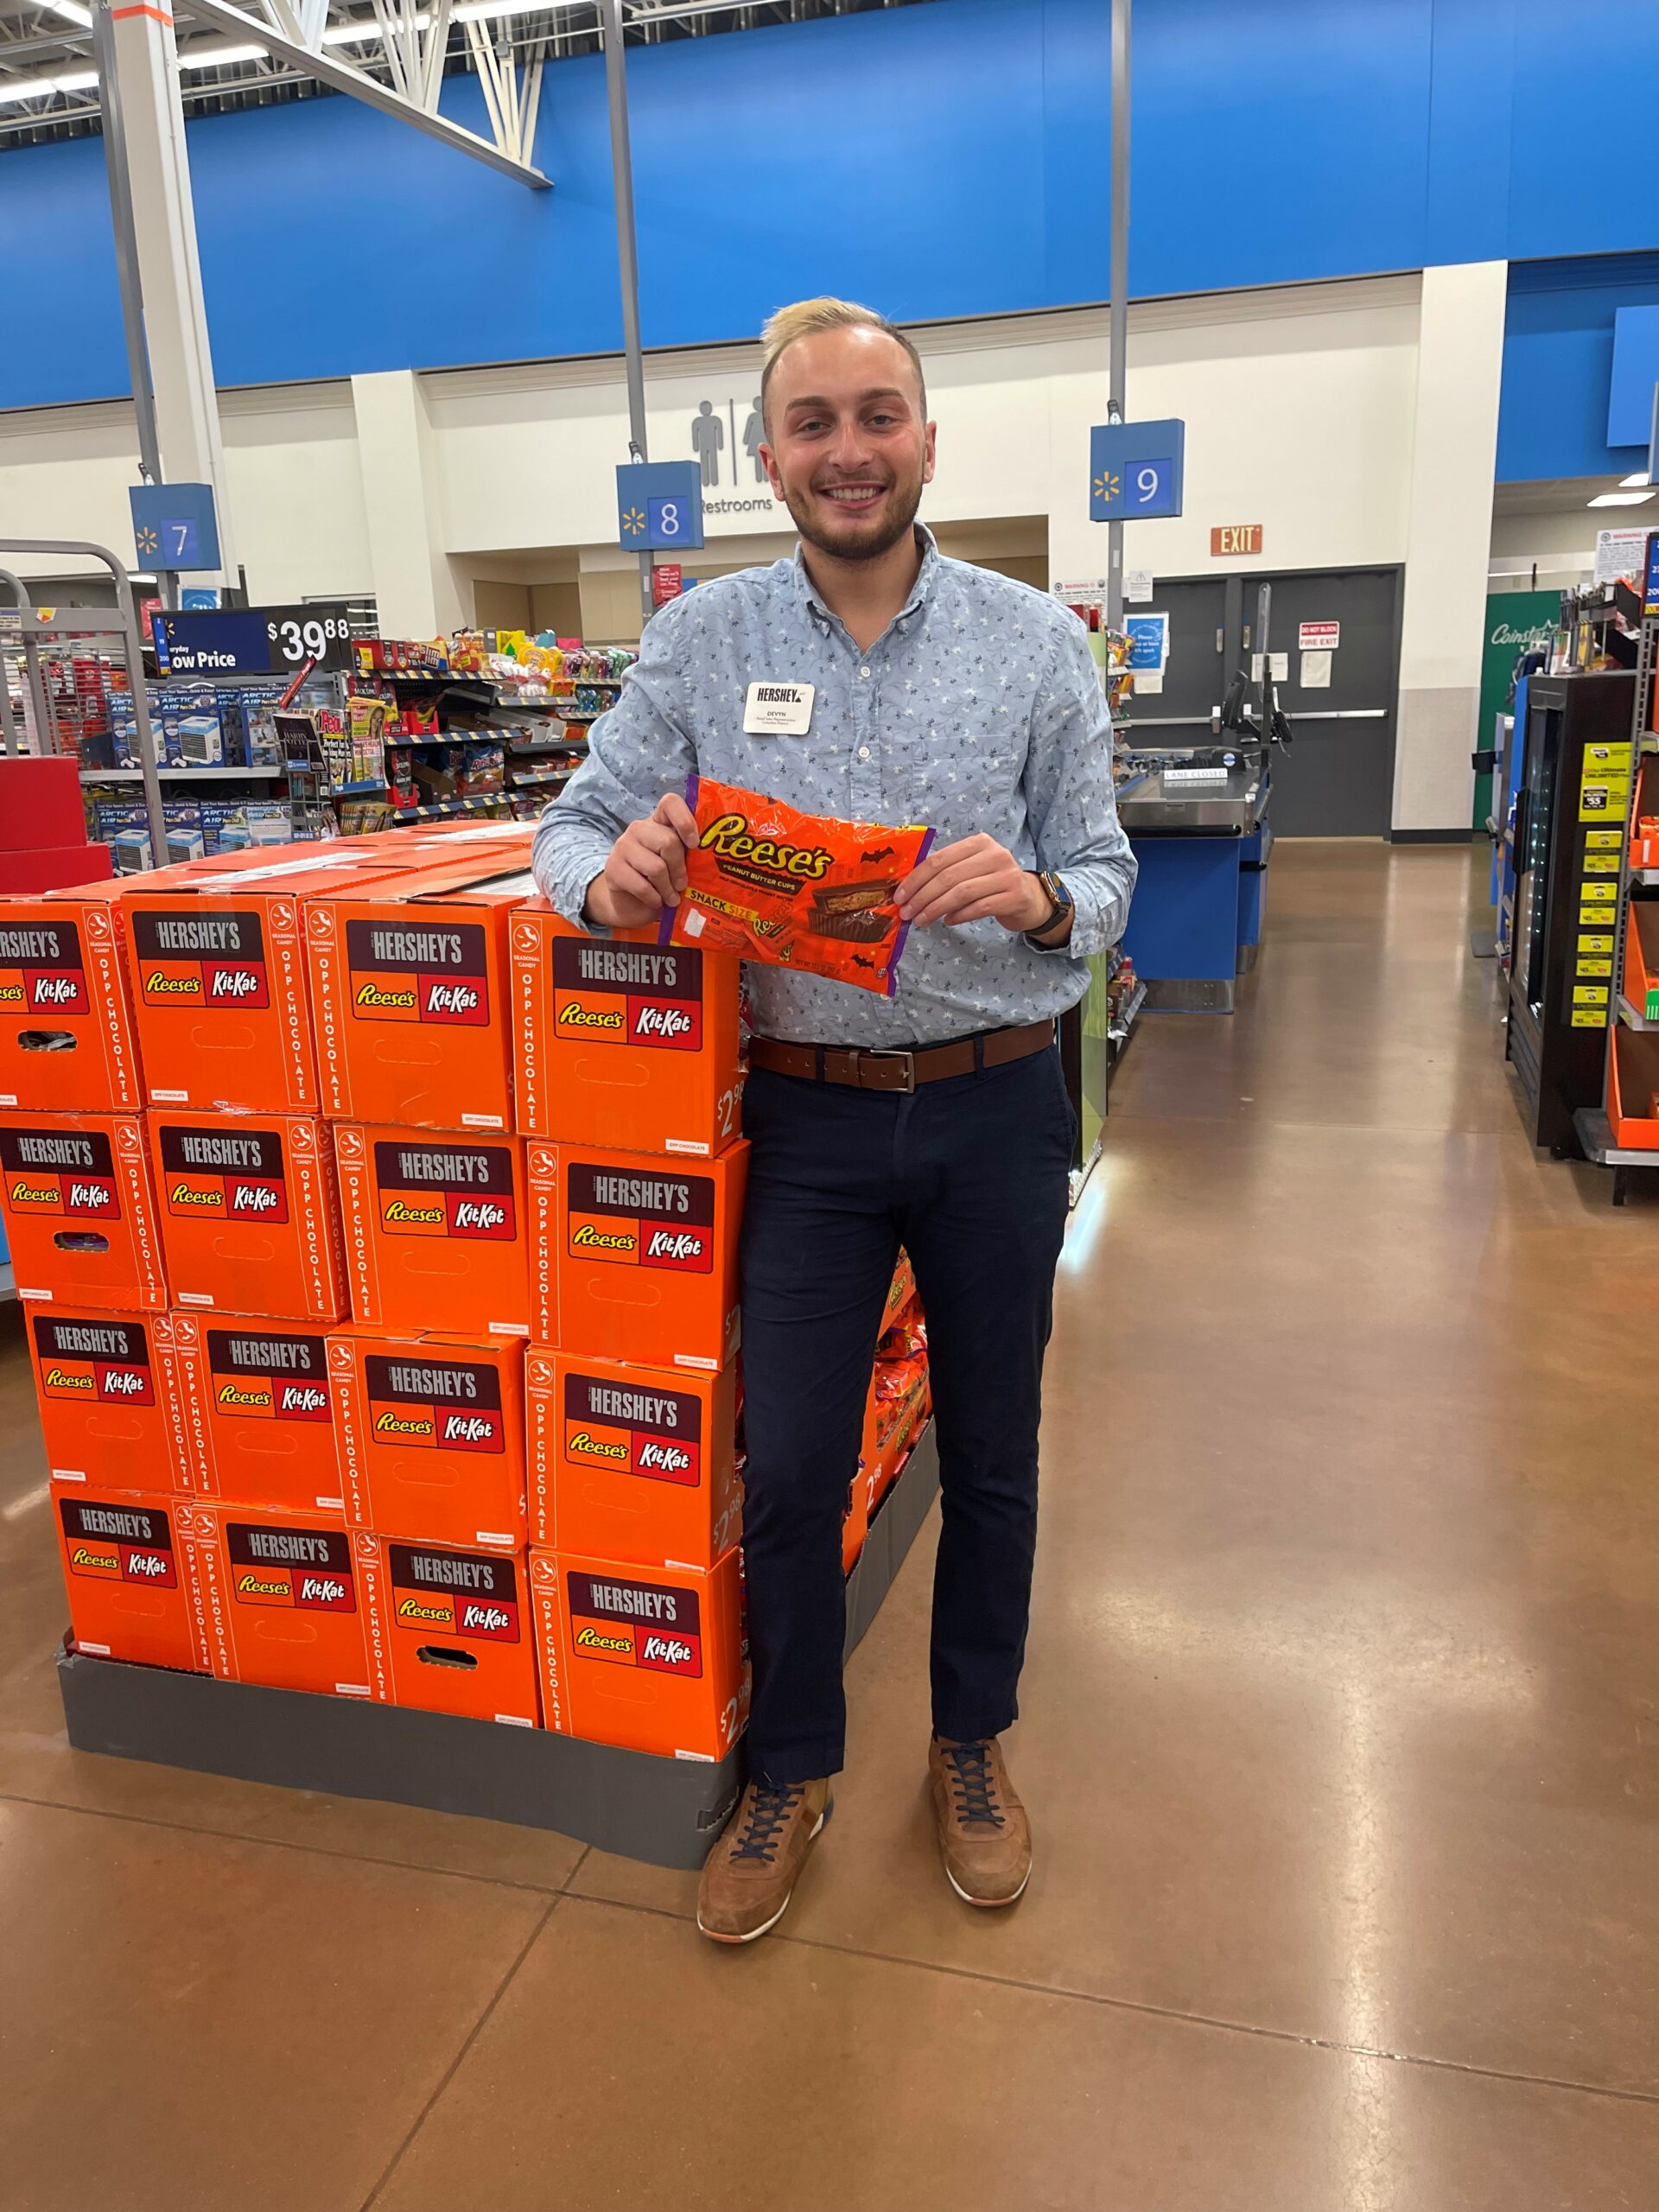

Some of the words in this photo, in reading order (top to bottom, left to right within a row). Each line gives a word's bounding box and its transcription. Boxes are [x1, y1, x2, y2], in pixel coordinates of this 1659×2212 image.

[1137, 468, 1158, 502] 9
[661, 504, 679, 535] 8
[171, 525, 188, 556] 7
[1220, 526, 1255, 554] EXIT
[1491, 621, 1549, 645] Coinstar
[198, 651, 236, 668] Price
[757, 688, 798, 702] HERSHEY
[699, 814, 832, 879] Reese's
[722, 864, 750, 877] PEANUT
[750, 874, 777, 885] BUTTER
[777, 880, 796, 891] CUPS
[690, 890, 727, 912] SNACK
[729, 904, 753, 919] SIZE
[0, 931, 60, 957] RSHEY'S
[157, 922, 240, 949] HERSHEY'S
[372, 931, 462, 963] HERSHEY'S
[320, 958, 329, 994] OPP
[579, 950, 677, 986] HERSHEY'S
[35, 979, 77, 1003] KitKat
[147, 972, 200, 994] Reese's
[212, 972, 257, 996] KitKat
[357, 984, 416, 1007] Reese's
[427, 985, 477, 1014] KitKat
[523, 975, 531, 1011] OPP
[99, 959, 111, 993] OPP
[106, 997, 128, 1102] CHOCOLATE
[281, 951, 293, 986] OPP
[287, 992, 305, 1100] CHOCOLATE
[560, 1004, 623, 1029] Reese's
[636, 1007, 690, 1036] KitKat
[324, 1001, 340, 1109] CHOCOLATE
[525, 1017, 537, 1128] CHOCOLATE
[18, 1137, 93, 1166] HERSHEY'S
[182, 1137, 262, 1166] HERSHEY'S
[399, 1153, 488, 1183] HERSHEY'S
[12, 1183, 60, 1202] Reese's
[70, 1184, 109, 1208] KitKat
[172, 1185, 222, 1205] Reese's
[234, 1186, 276, 1211] KitKat
[349, 1177, 359, 1210] OPP
[594, 1175, 689, 1212] HERSHEY'S
[385, 1202, 443, 1223] Reese's
[455, 1203, 504, 1228] KitKat
[538, 1197, 548, 1230] OPP
[129, 1169, 140, 1198] OPP
[135, 1205, 156, 1302] CHOCOLATE
[301, 1171, 310, 1203] OPP
[306, 1209, 324, 1309] CHOCOLATE
[574, 1226, 635, 1250] Reese's
[648, 1231, 701, 1260] KitKat
[353, 1216, 370, 1317] CHOCOLATE
[538, 1237, 549, 1339] CHOCOLATE
[54, 1326, 128, 1354] HERSHEY'S
[229, 1340, 310, 1369] HERSHEY'S
[48, 1370, 93, 1389] Reese's
[105, 1371, 143, 1395] KitKat
[186, 1362, 195, 1392] OPP
[389, 1366, 476, 1397] HERSHEY'S
[219, 1386, 270, 1406] Reese's
[282, 1389, 325, 1412] KitKat
[340, 1389, 351, 1419] OPP
[589, 1386, 677, 1427] HERSHEY'S
[164, 1358, 174, 1388] OPP
[170, 1394, 189, 1485] CHOCOLATE
[377, 1414, 432, 1434] Reese's
[444, 1416, 492, 1441] KitKat
[190, 1398, 209, 1491] CHOCOLATE
[569, 1433, 627, 1459] Reese's
[639, 1444, 689, 1471] KitKat
[345, 1426, 362, 1522] CHOCOLATE
[537, 1441, 546, 1539] CHOCOLATE
[80, 1509, 151, 1538] HERSHEY'S
[73, 1549, 118, 1569] Reese's
[129, 1554, 166, 1575] KitKat
[249, 1534, 328, 1562] HERSHEY'S
[206, 1554, 215, 1581] OPP
[412, 1556, 493, 1589] HERSHEY'S
[239, 1575, 289, 1595] Reese's
[302, 1579, 344, 1601] KitKat
[590, 1584, 676, 1621] HERSHEY'S
[187, 1545, 195, 1572] OPP
[192, 1579, 208, 1664] CHOCOLATE
[399, 1599, 452, 1622] Reese's
[463, 1606, 507, 1630] KitKat
[543, 1601, 551, 1631] OPP
[210, 1587, 229, 1675] CHOCOLATE
[366, 1573, 375, 1603] OPP
[371, 1608, 385, 1699] CHOCOLATE
[577, 1629, 632, 1653] Reese's
[644, 1637, 690, 1663] KitKat
[546, 1638, 561, 1731] CHOCOLATE
